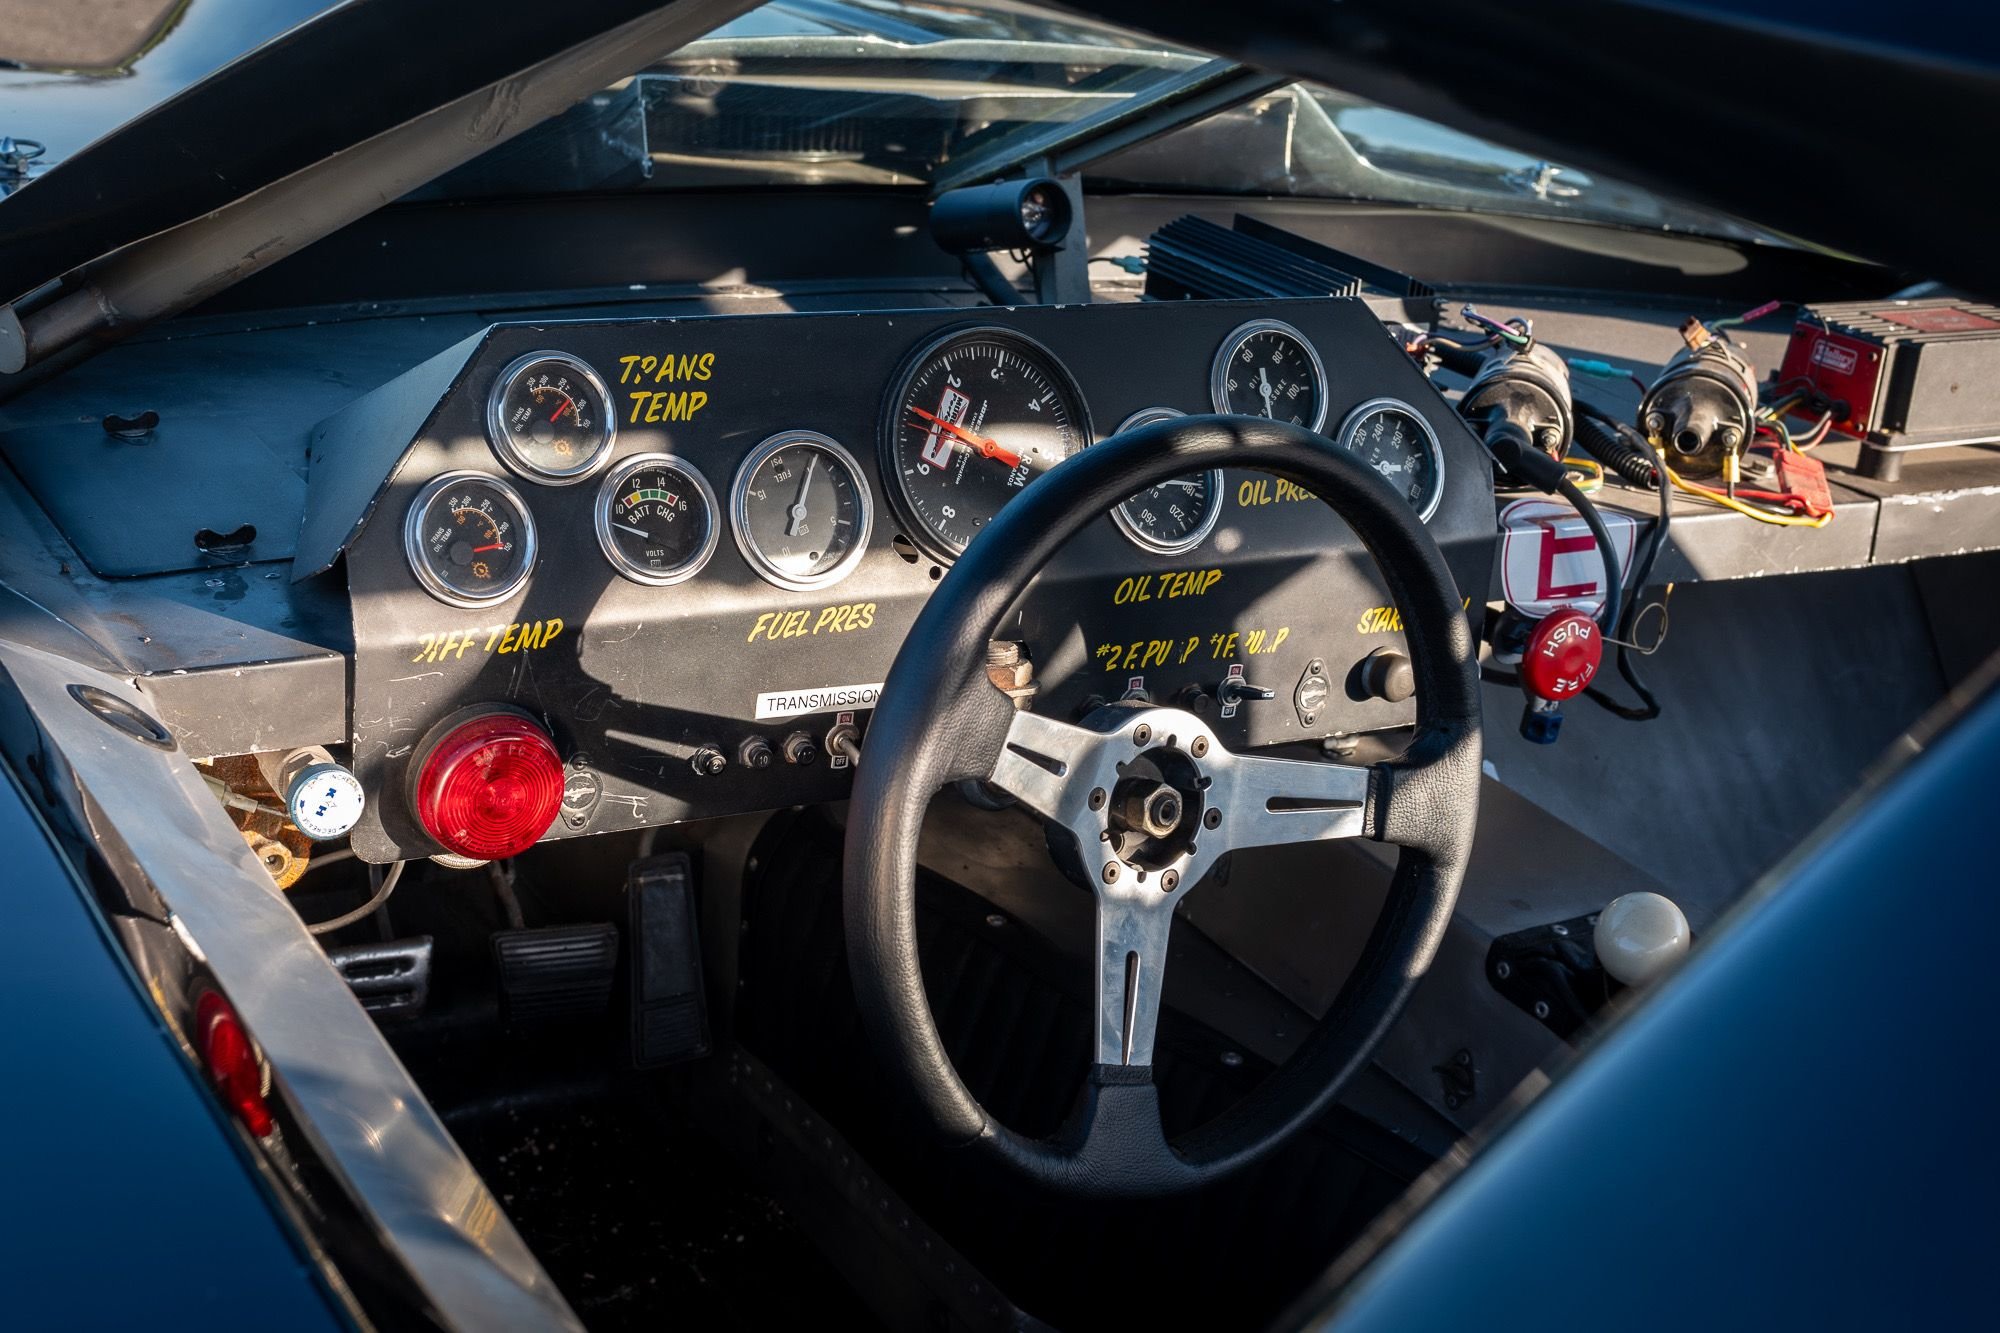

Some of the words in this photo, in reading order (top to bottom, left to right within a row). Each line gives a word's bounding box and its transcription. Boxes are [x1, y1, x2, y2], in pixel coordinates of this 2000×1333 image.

[1242, 349, 1254, 363] 60
[1272, 350, 1284, 364] 80
[946, 373, 962, 389] 2
[1227, 379, 1238, 392] 40
[1248, 375, 1260, 389] OIL
[1258, 378, 1288, 417] PRSSURE
[1286, 383, 1300, 400] 100
[578, 399, 587, 410] 200
[629, 391, 708, 423] TEMP
[1027, 398, 1041, 412] 4
[511, 406, 525, 423] TRANS
[515, 423, 524, 432] OIL
[521, 407, 533, 423] TEMP
[974, 399, 988, 431] JONES
[583, 419, 591, 428] 150
[1354, 428, 1367, 446] 220
[1372, 423, 1384, 442] 240
[1391, 430, 1403, 449] 250
[770, 456, 783, 468] PSI
[1404, 455, 1416, 474] 265
[657, 476, 666, 487] 14
[774, 468, 792, 483] FUEL
[632, 478, 641, 489] 12
[757, 489, 767, 501] 15
[1238, 479, 1271, 507] OIL
[1274, 478, 1317, 503] PRE
[462, 495, 472, 506] 300
[480, 499, 490, 510] 250
[678, 500, 687, 511] 16
[615, 504, 624, 515] 10
[628, 504, 650, 525] BATT
[656, 505, 675, 522] CHG
[941, 505, 956, 519] 8
[1169, 504, 1185, 522] 220
[830, 516, 837, 527] 5
[1140, 508, 1157, 527] 260
[500, 521, 509, 533] 200
[430, 527, 445, 544] TRANS
[433, 544, 443, 553] OIL
[441, 528, 452, 543] TEMP
[503, 542, 513, 552] 150
[645, 549, 665, 557] VOLTS
[782, 546, 791, 557] 10
[1114, 577, 1151, 605] OIL
[1157, 568, 1222, 599] TEMP
[747, 610, 811, 643] FUEL
[812, 603, 877, 635] PRES
[1356, 606, 1405, 635] STAR
[483, 617, 564, 654] TEMP
[1543, 621, 1592, 657] PUSH
[1231, 667, 1240, 675] ON
[1552, 663, 1594, 693] FIRE
[1132, 680, 1141, 688] ON
[767, 688, 881, 712] TRANSMISSION
[1224, 707, 1234, 715] OFF
[841, 715, 851, 723] ON
[712, 762, 719, 770] 2
[759, 755, 769, 764] 10
[835, 758, 846, 766] OFF
